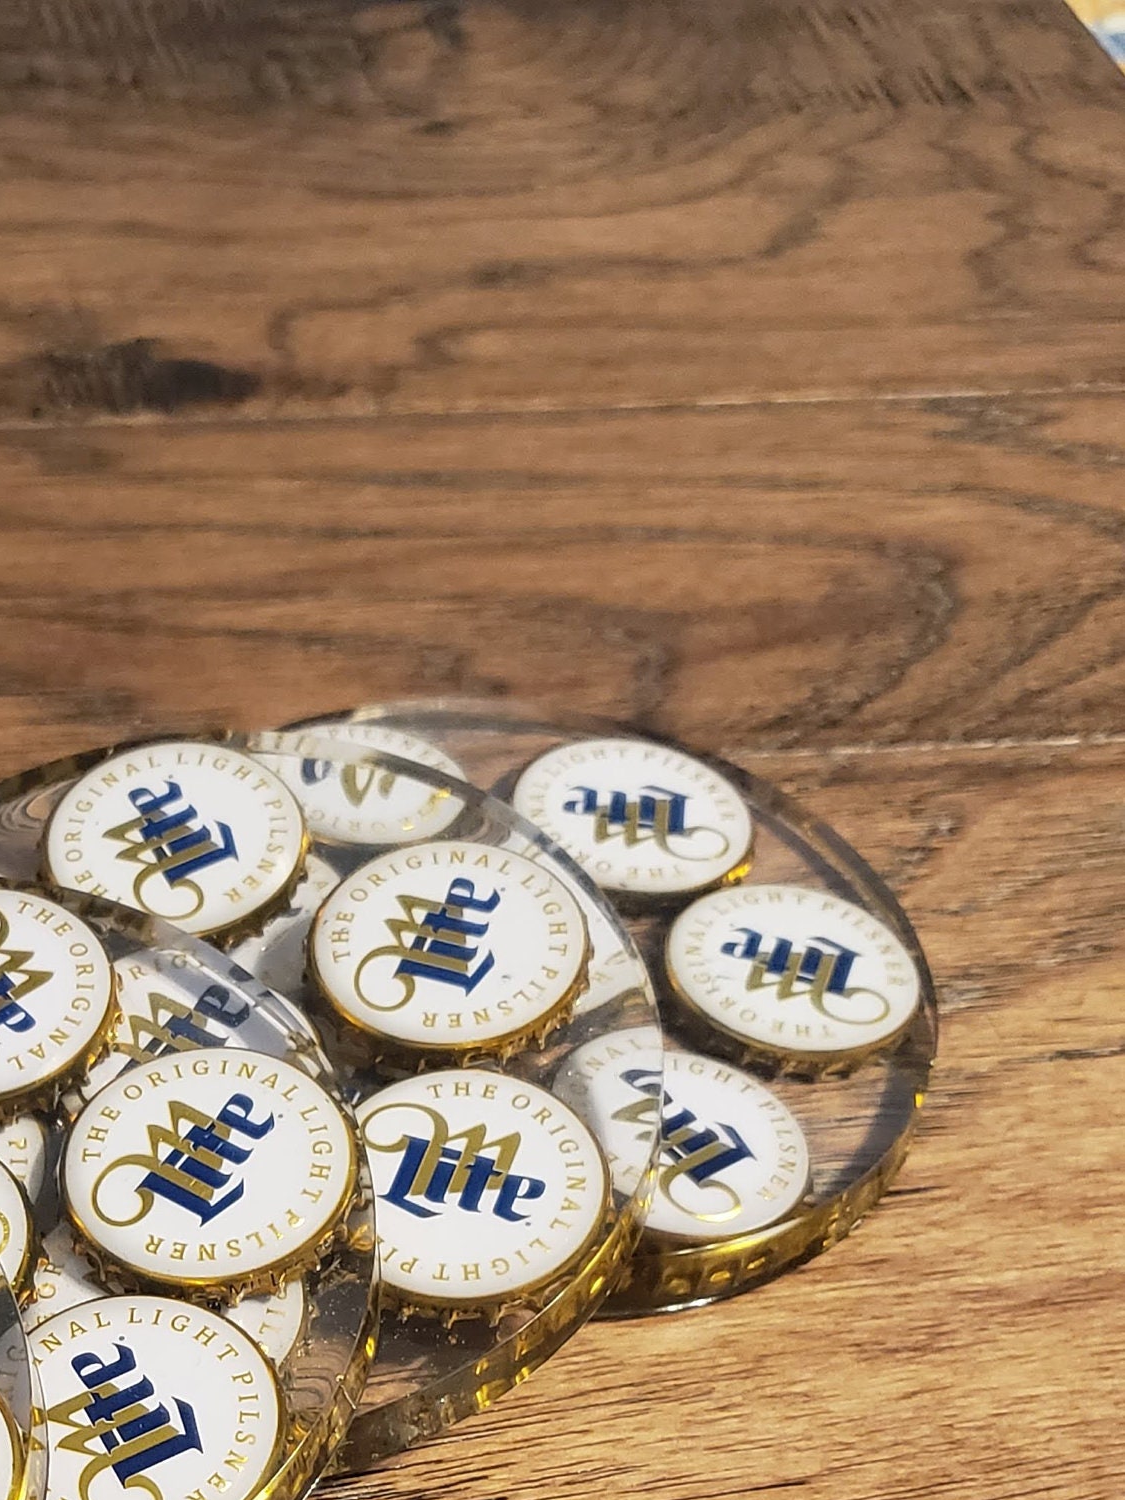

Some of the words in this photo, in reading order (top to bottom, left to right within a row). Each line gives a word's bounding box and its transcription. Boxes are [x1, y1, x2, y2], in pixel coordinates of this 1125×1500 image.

[177, 753, 270, 792] LIGHT
[65, 756, 161, 862] ORIGINAL
[128, 780, 239, 889] Lite
[224, 800, 288, 904] PILSNER
[350, 851, 511, 901] ORIGINAL
[75, 870, 121, 901] HE
[521, 875, 567, 957] LIGHT
[17, 901, 73, 936] THE
[332, 913, 354, 963] THE
[392, 877, 500, 997] Lite
[7, 943, 94, 1070] ORIGINAL
[423, 965, 559, 1027] PILSNER
[124, 1060, 299, 1101] ORIGINAL
[427, 1082, 498, 1099] THE
[82, 1106, 121, 1163] THE
[134, 1093, 275, 1227] Lite
[300, 1106, 333, 1203] LIGHT
[512, 1094, 587, 1229] ORIGINAL
[376, 1135, 546, 1222] Lite
[145, 1209, 304, 1261] PILSNER
[432, 1238, 550, 1280] LIGHT
[128, 1307, 239, 1362] LIGHT
[71, 1343, 203, 1489] Lite
